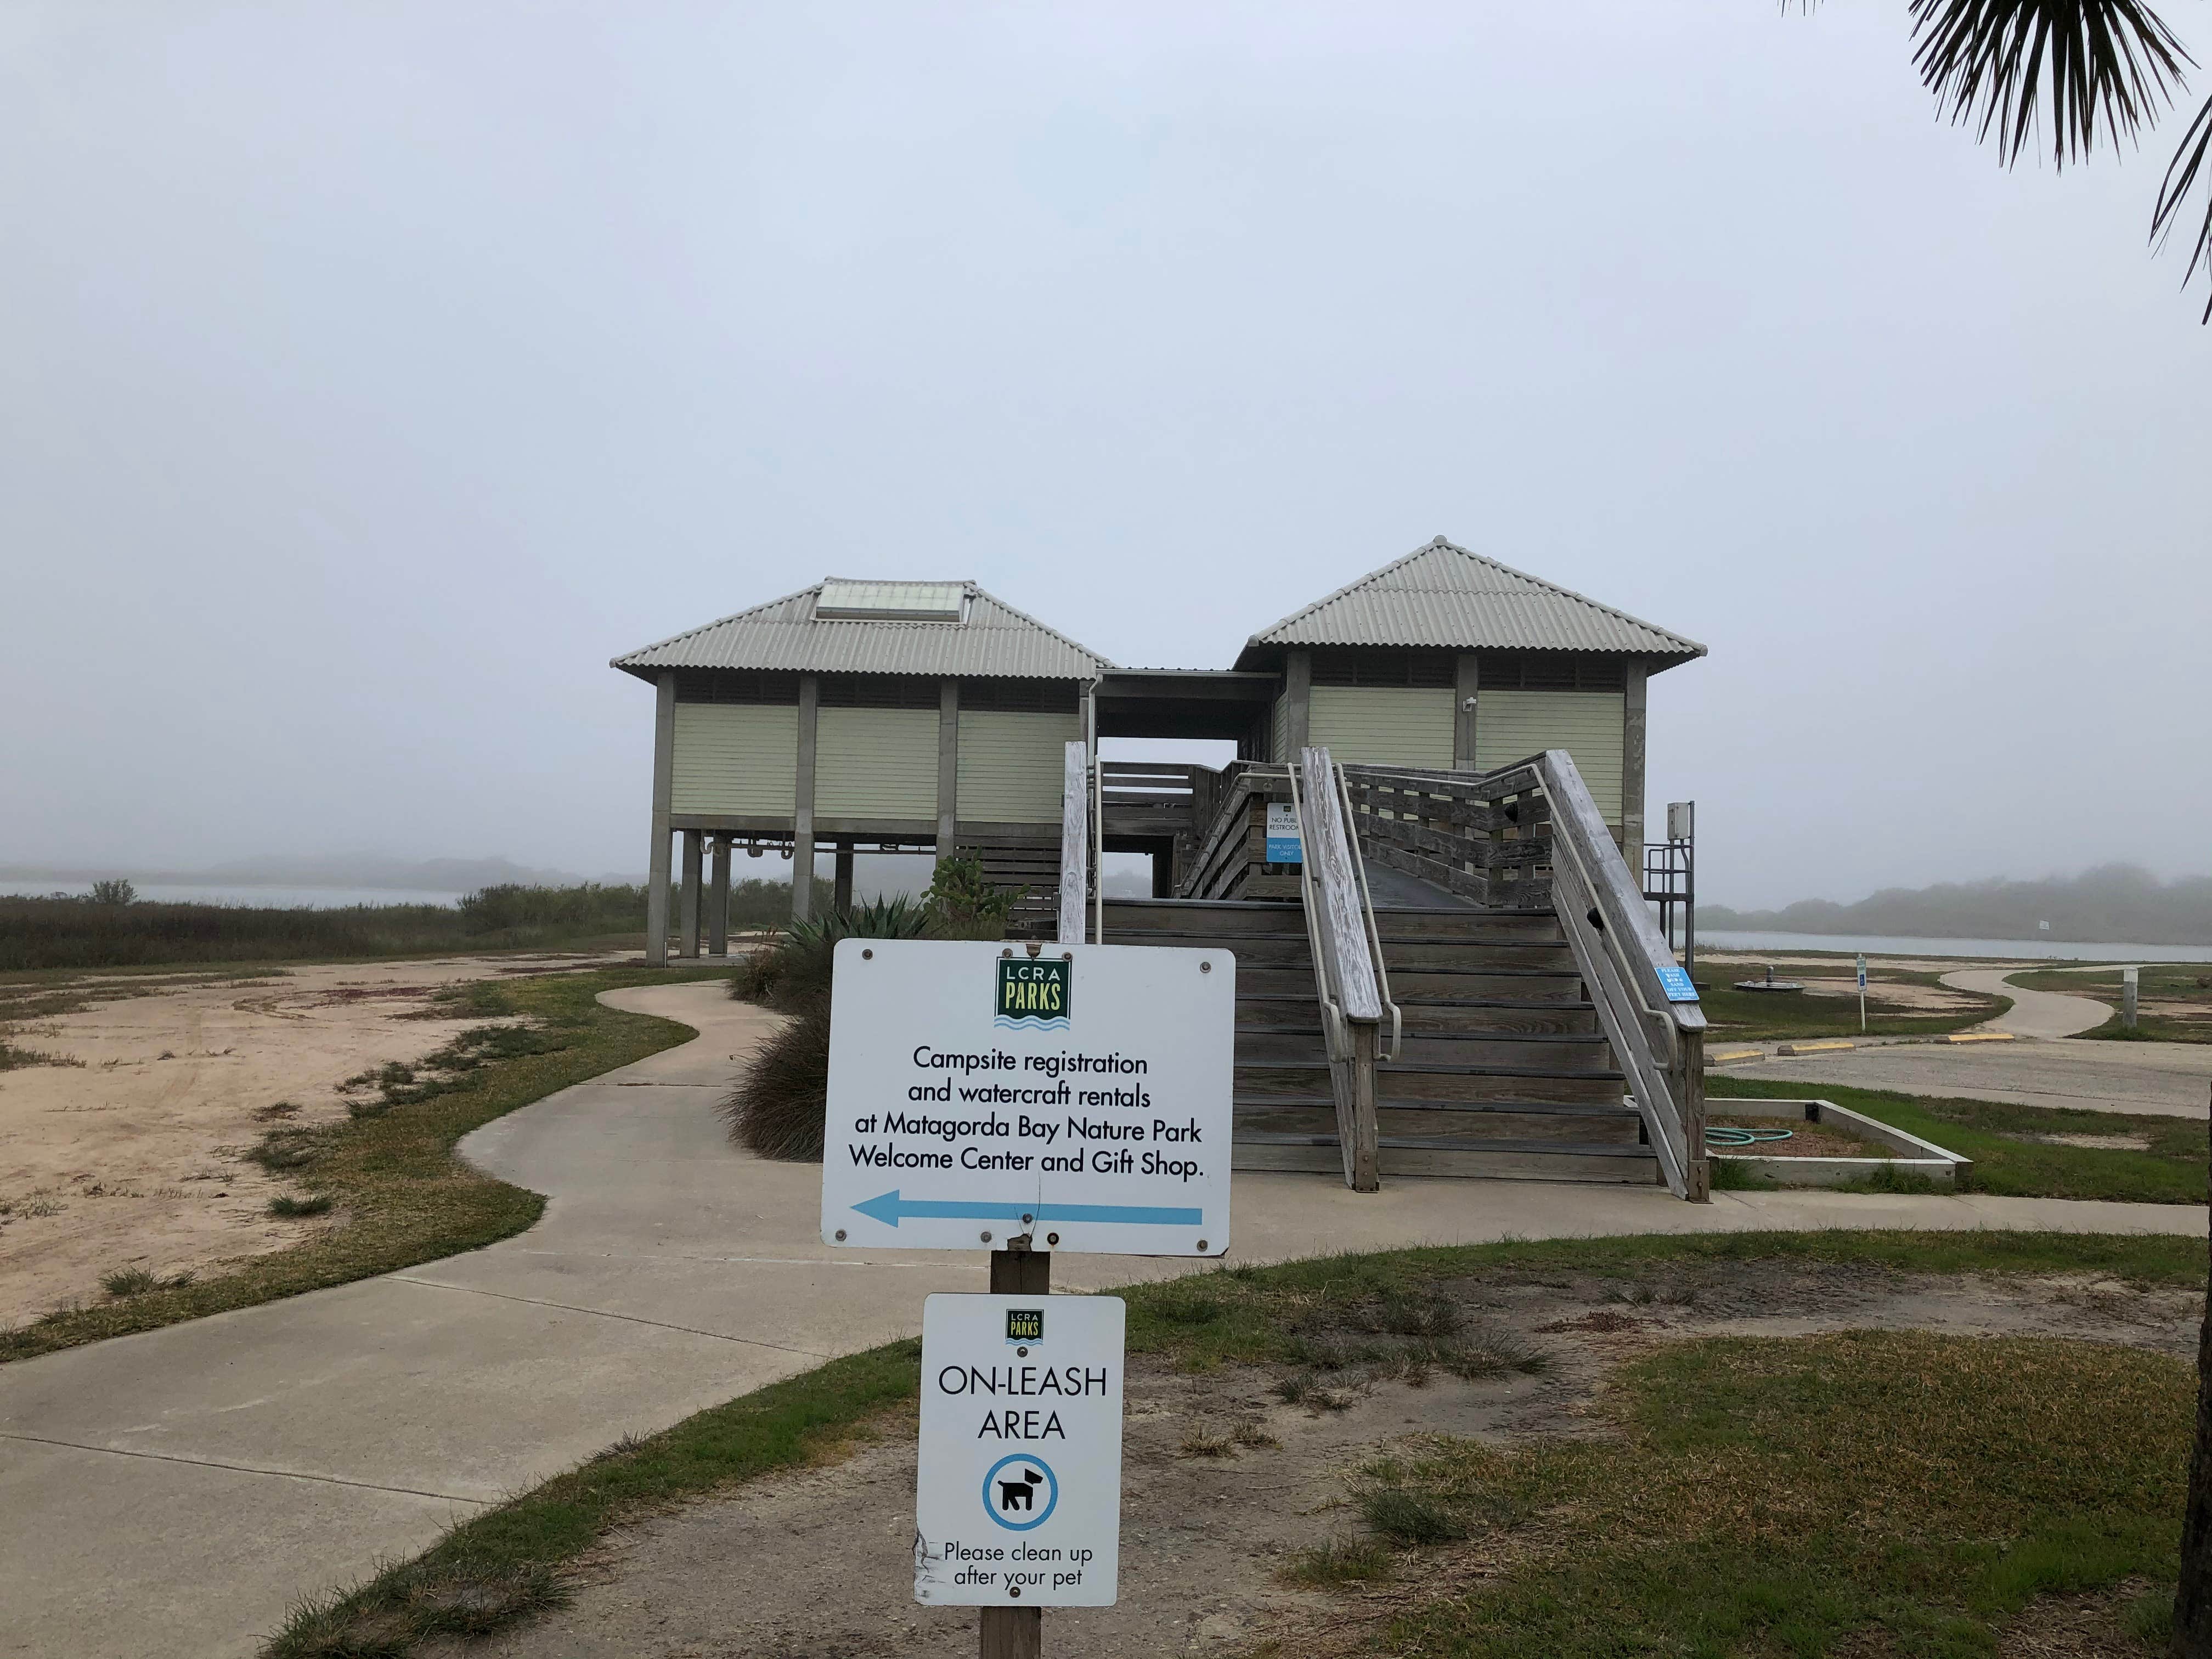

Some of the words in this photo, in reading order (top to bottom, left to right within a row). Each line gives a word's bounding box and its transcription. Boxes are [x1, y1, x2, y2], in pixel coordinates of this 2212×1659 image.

[1007, 967, 1060, 981] LCRA
[1006, 982, 1060, 1011] PARKS
[913, 1046, 1016, 1075] Campsite
[1025, 1050, 1147, 1077] registration
[909, 1077, 951, 1101] and
[958, 1080, 1071, 1104] watercraft
[1079, 1083, 1150, 1107] rentals
[855, 1114, 877, 1133] at
[884, 1111, 1009, 1142] Matagorda
[1019, 1115, 1060, 1144] Bay
[1068, 1116, 1145, 1141] Nature
[1154, 1118, 1202, 1143] Park
[849, 1142, 953, 1169] Welcome
[961, 1147, 1034, 1170] Center
[1041, 1148, 1084, 1172] and
[1092, 1150, 1133, 1173] Gift
[1141, 1150, 1204, 1182] Shop.
[1011, 1321, 1039, 1336] PARKS
[939, 1365, 1106, 1396] ON-LEASH
[978, 1410, 1065, 1439] AREA
[945, 1542, 1004, 1561] Please
[1011, 1541, 1061, 1561] clean
[1069, 1550, 1092, 1566] up
[954, 1565, 997, 1585] after
[1005, 1572, 1046, 1590] your
[1053, 1570, 1082, 1590] pet
